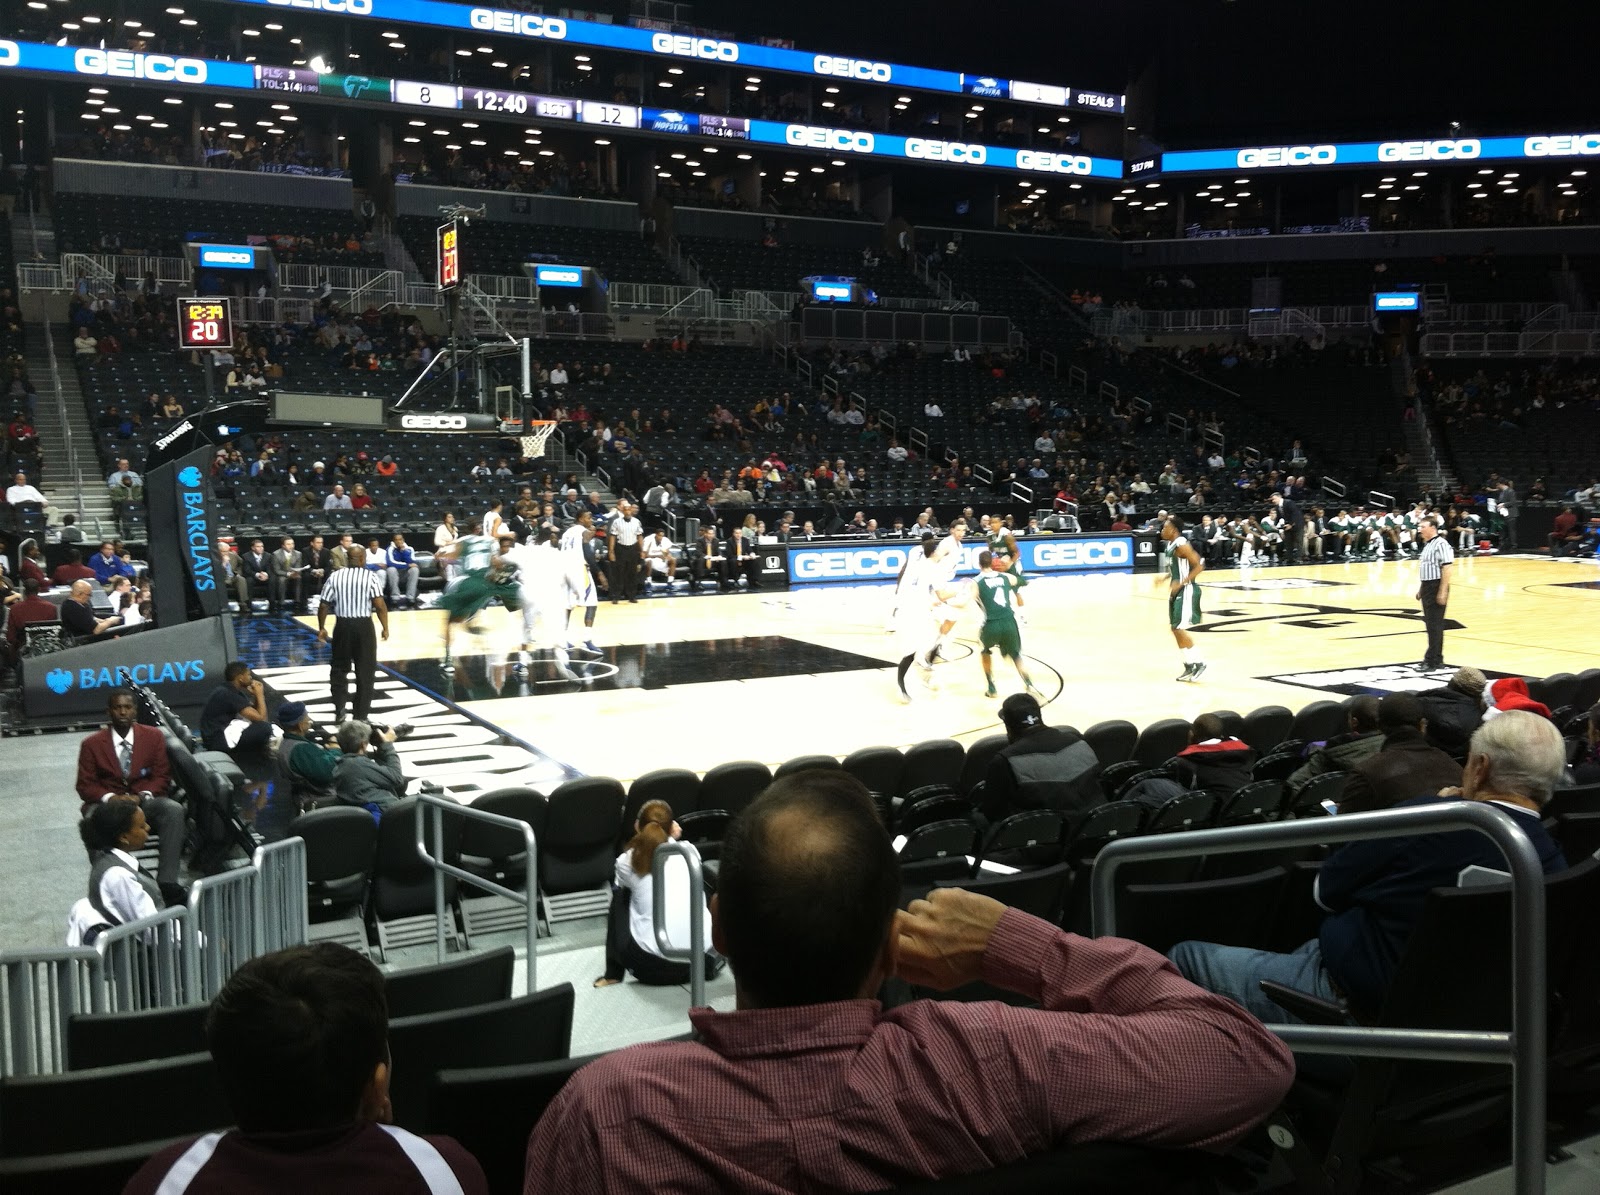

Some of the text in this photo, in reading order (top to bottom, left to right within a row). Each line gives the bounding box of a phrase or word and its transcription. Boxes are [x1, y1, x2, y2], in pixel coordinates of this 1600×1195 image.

[470, 9, 567, 40] GEICO
[652, 33, 739, 62] GEICO
[75, 48, 208, 84] GEICO
[813, 55, 892, 82] GEICO
[419, 86, 431, 103] 8
[473, 91, 527, 114] 12:40
[1077, 93, 1115, 108] STEALS
[600, 107, 622, 124] 12
[785, 124, 875, 153] GEICO
[904, 137, 987, 165] GEICO
[1377, 138, 1482, 163] GEICO
[1016, 149, 1093, 175] GEICO
[1236, 145, 1337, 169] GEICO
[192, 321, 218, 340] 20
[155, 420, 194, 450] SPALDING
[401, 415, 467, 429] GEICO
[182, 492, 217, 593] BARCLAYS
[1033, 542, 1130, 568] GEICO
[795, 550, 907, 578] GEICO
[79, 659, 206, 690] BARCLAYS
